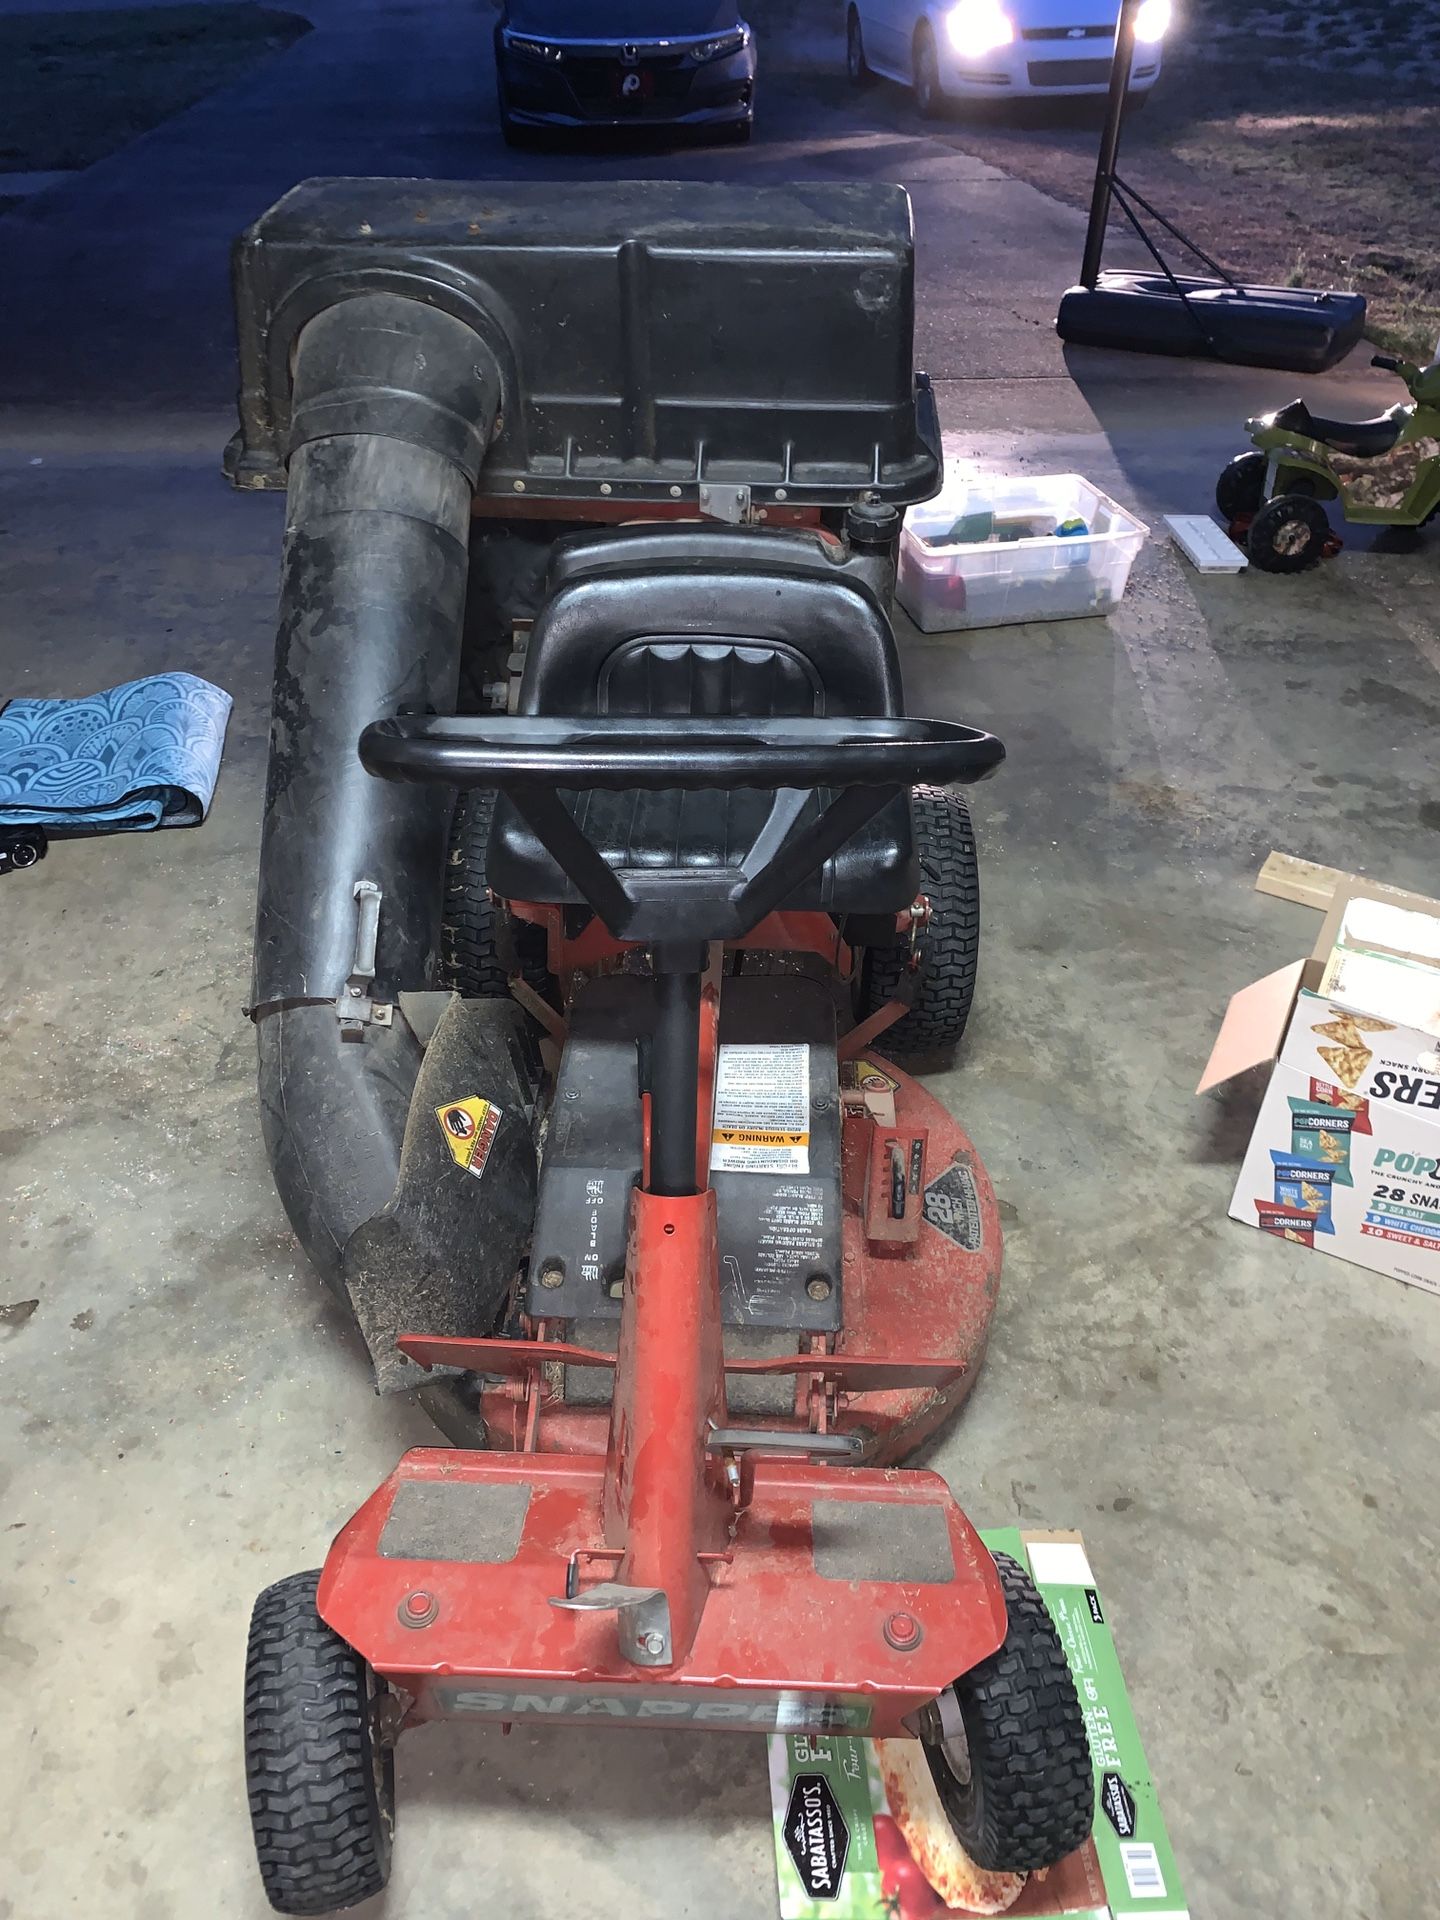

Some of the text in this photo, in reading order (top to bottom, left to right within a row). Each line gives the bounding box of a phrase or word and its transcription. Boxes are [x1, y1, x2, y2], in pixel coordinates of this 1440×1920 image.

[1379, 1060, 1410, 1070] SNACK
[471, 1111, 499, 1169] DANGER
[738, 1134, 785, 1143] WARNING
[1386, 1173, 1423, 1185] CRUNCHY
[1373, 1185, 1440, 1210] 28 SNA
[925, 1192, 954, 1224] 28
[1378, 1202, 1425, 1218] 9 SEA SALT
[1372, 1215, 1381, 1223] 9
[1384, 1217, 1410, 1230] WHITE
[1366, 1226, 1384, 1236] 10
[1386, 1231, 1413, 1243] SWEET
[584, 1253, 599, 1261] ON
[1083, 1711, 1106, 1768] GLUTEN
[1093, 1706, 1122, 1768] FREE
[803, 1783, 832, 1890] SABATASSO'S
